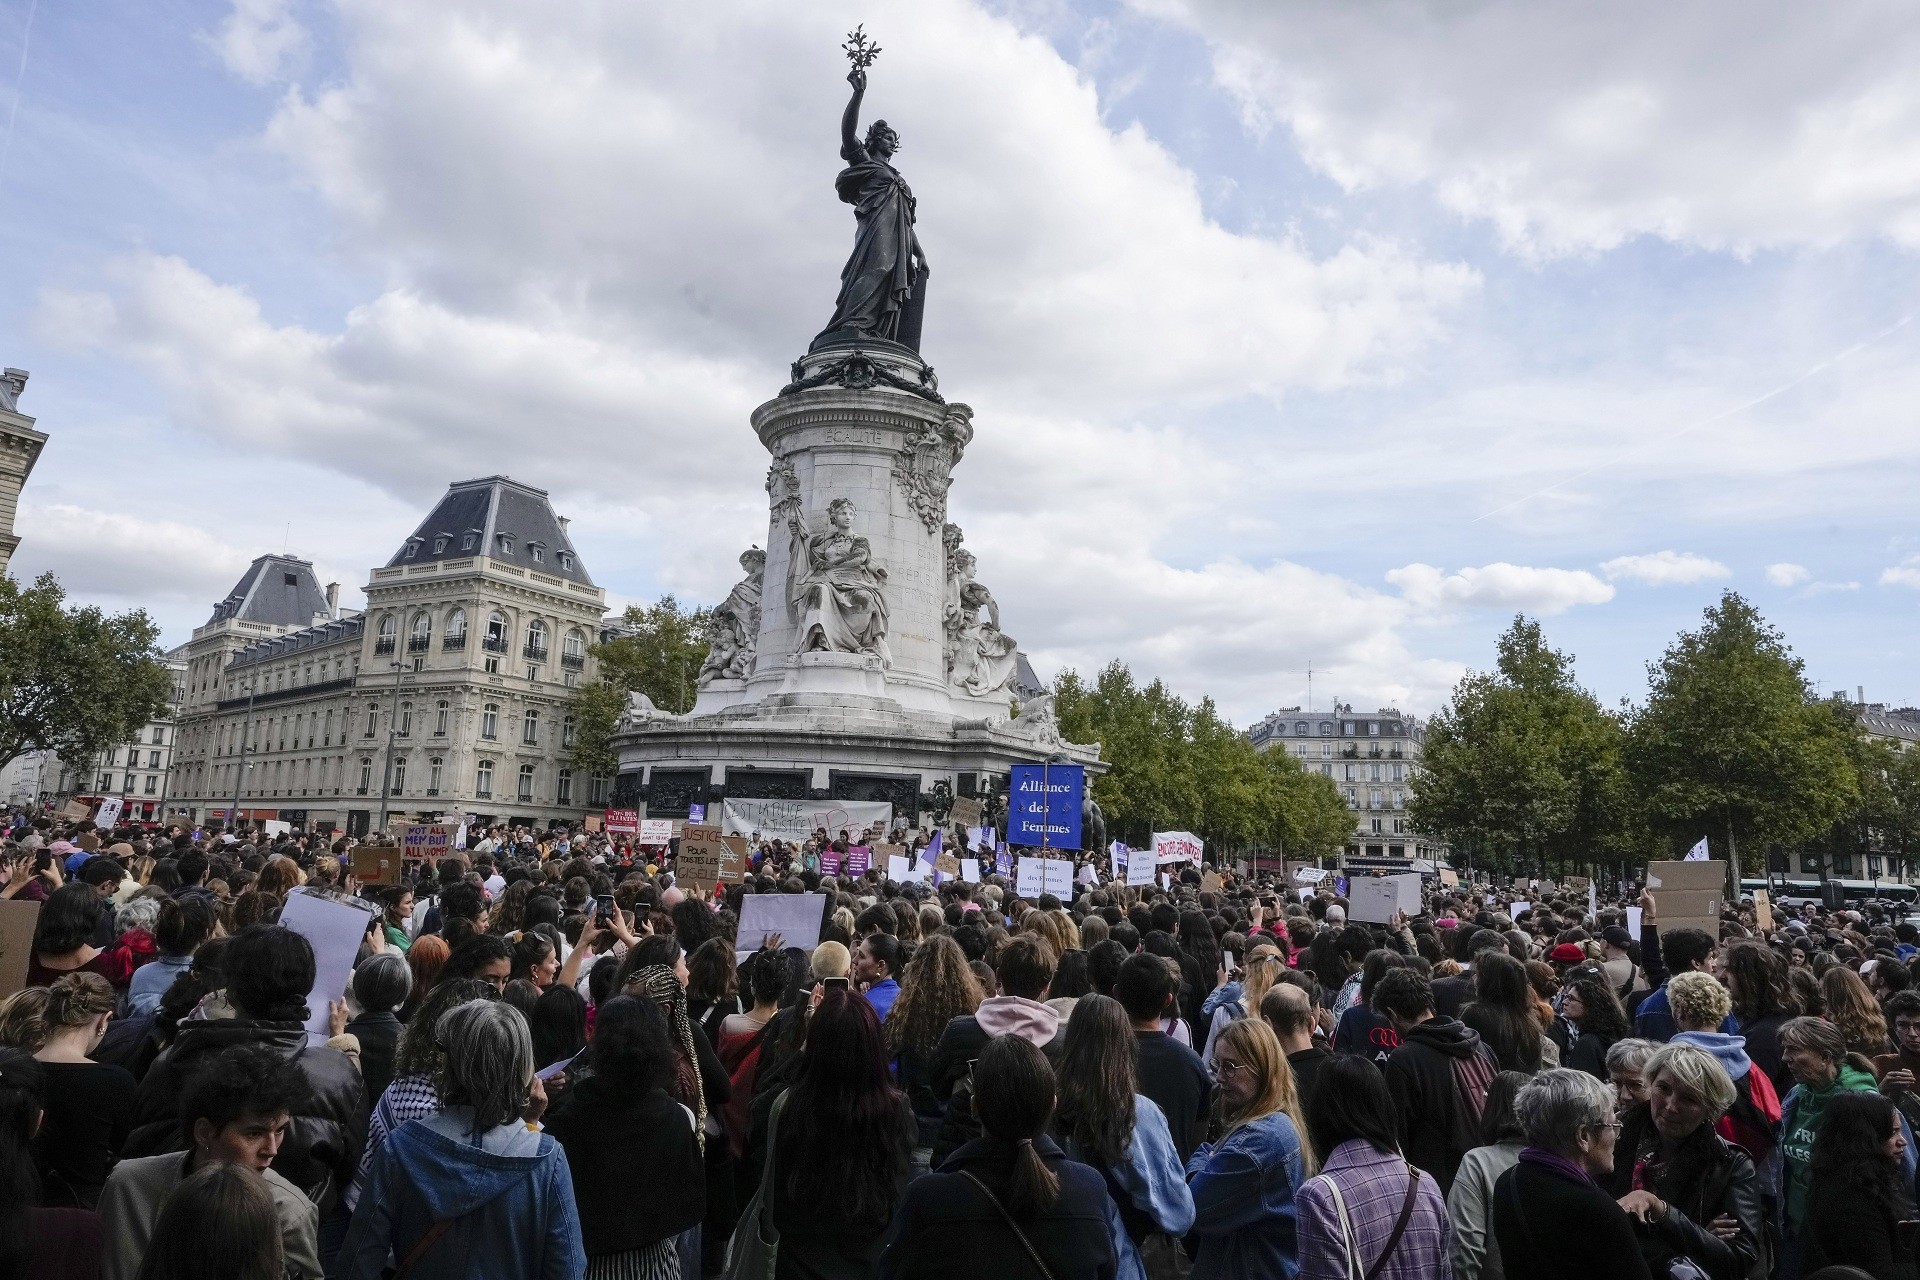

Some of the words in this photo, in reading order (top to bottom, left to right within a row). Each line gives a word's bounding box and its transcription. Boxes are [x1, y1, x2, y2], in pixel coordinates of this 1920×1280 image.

[1019, 780, 1071, 793] Alliance
[1028, 801, 1050, 813] des
[408, 827, 427, 835] NOT
[430, 827, 446, 835] ALL
[770, 819, 806, 834] JUSTICE
[1021, 820, 1071, 834] Femmes
[405, 835, 427, 845] MEN
[428, 835, 447, 845] BUT
[681, 828, 722, 843] JUSTICE
[405, 846, 423, 857] ALL
[686, 845, 708, 855] POUR
[706, 857, 719, 865] LES
[677, 864, 719, 881] GISÈLE
